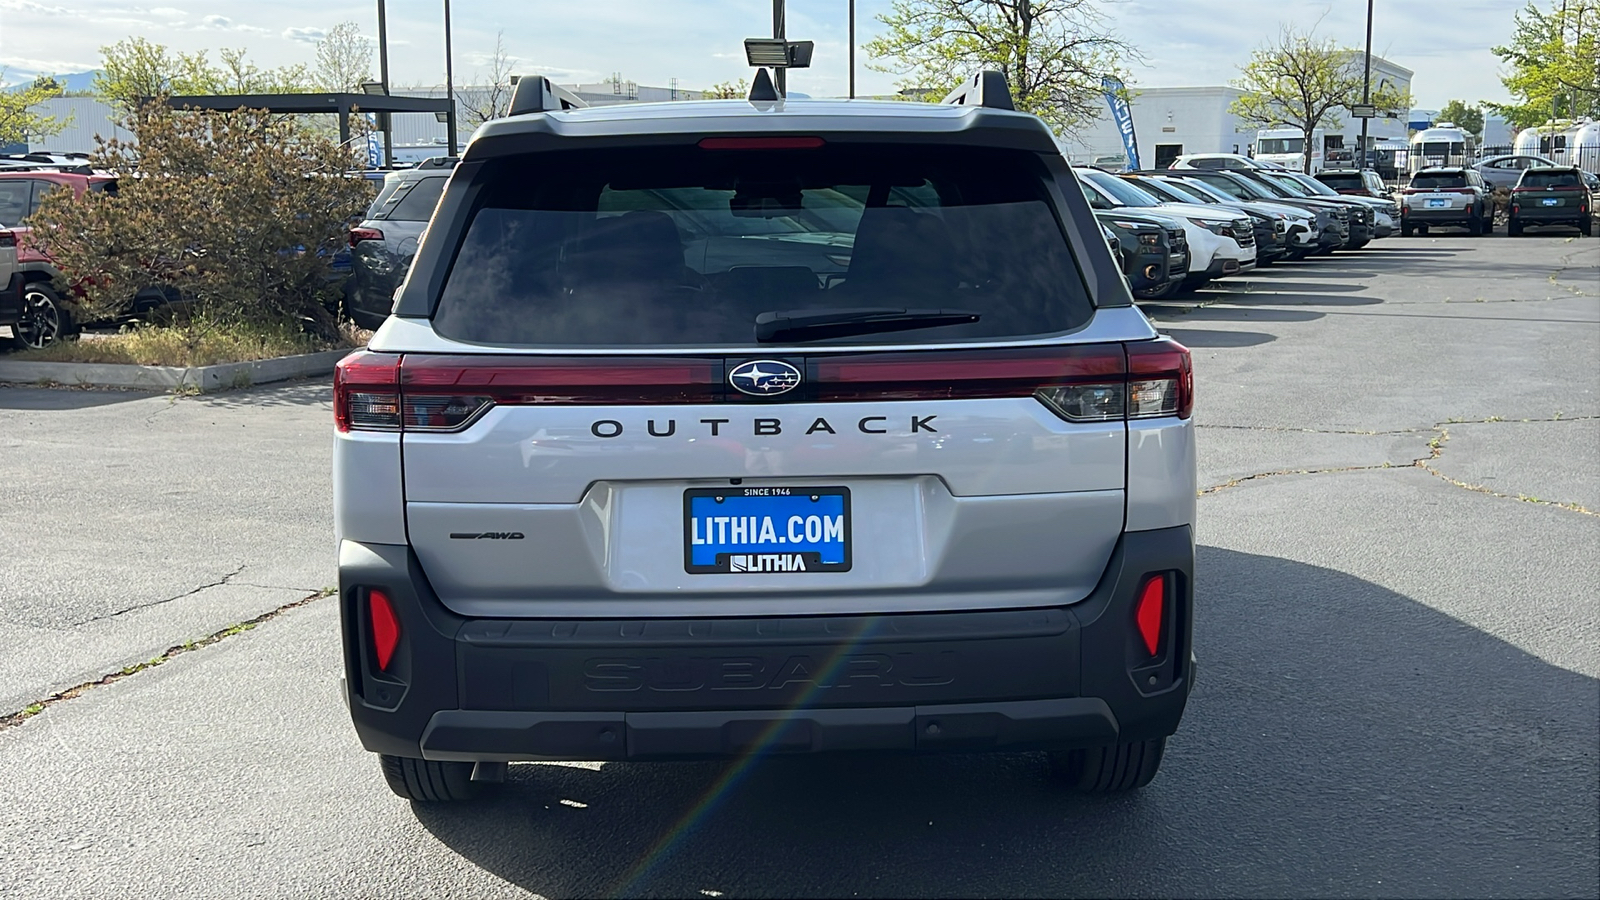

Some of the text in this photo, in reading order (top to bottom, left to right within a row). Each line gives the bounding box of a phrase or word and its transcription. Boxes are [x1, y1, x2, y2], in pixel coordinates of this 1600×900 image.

[590, 415, 938, 438] OUTBACK
[744, 488, 791, 496] SINCE 1946
[477, 532, 525, 540] AWD
[691, 515, 844, 545] LITHIA.COM
[747, 554, 806, 571] LITHIA
[582, 650, 956, 692] SUBARU
